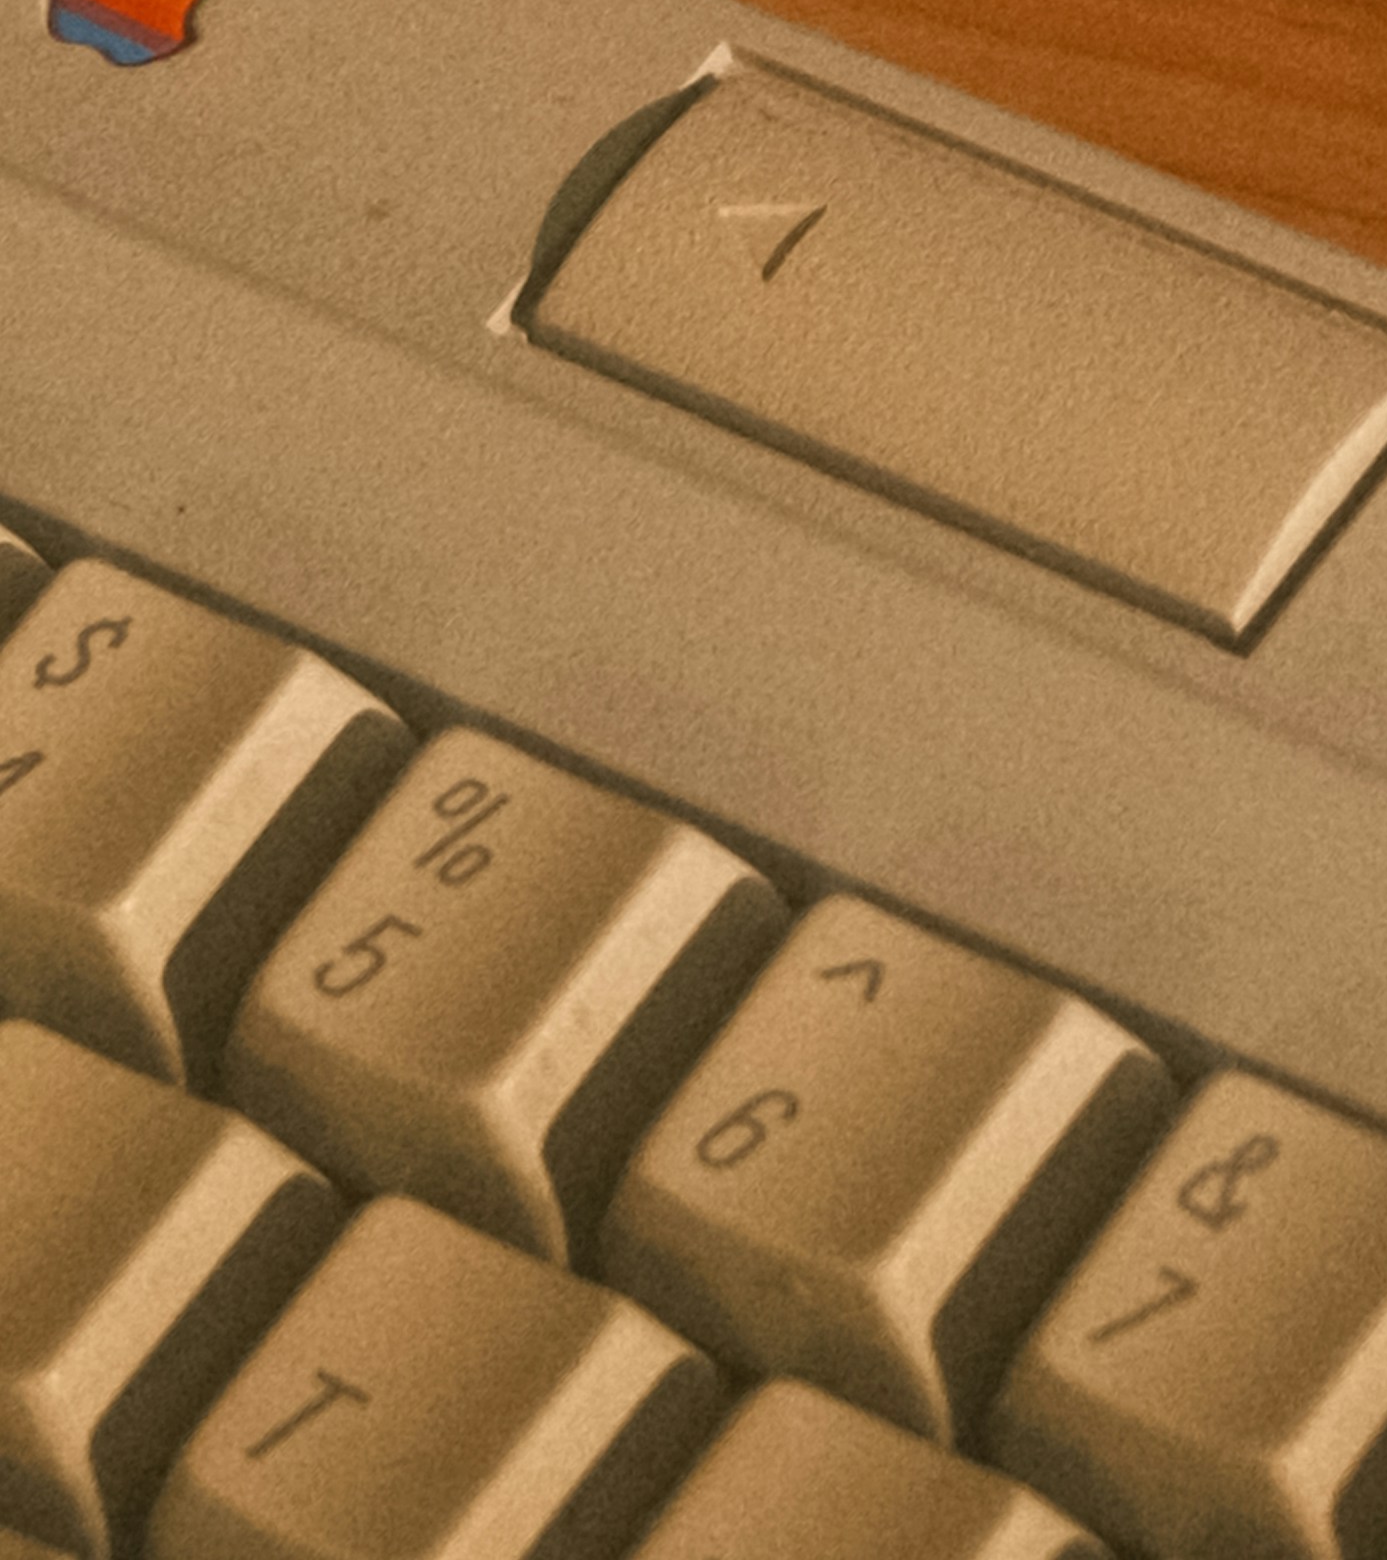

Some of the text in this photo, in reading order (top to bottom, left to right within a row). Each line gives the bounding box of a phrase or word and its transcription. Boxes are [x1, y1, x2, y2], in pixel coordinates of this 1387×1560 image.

[33, 617, 133, 690] $
[413, 777, 510, 888] %
[312, 913, 423, 1000] 5
[695, 1088, 799, 1171] 6
[1176, 1133, 1282, 1230] &
[1087, 1265, 1200, 1345] 7
[243, 1366, 373, 1459] T
